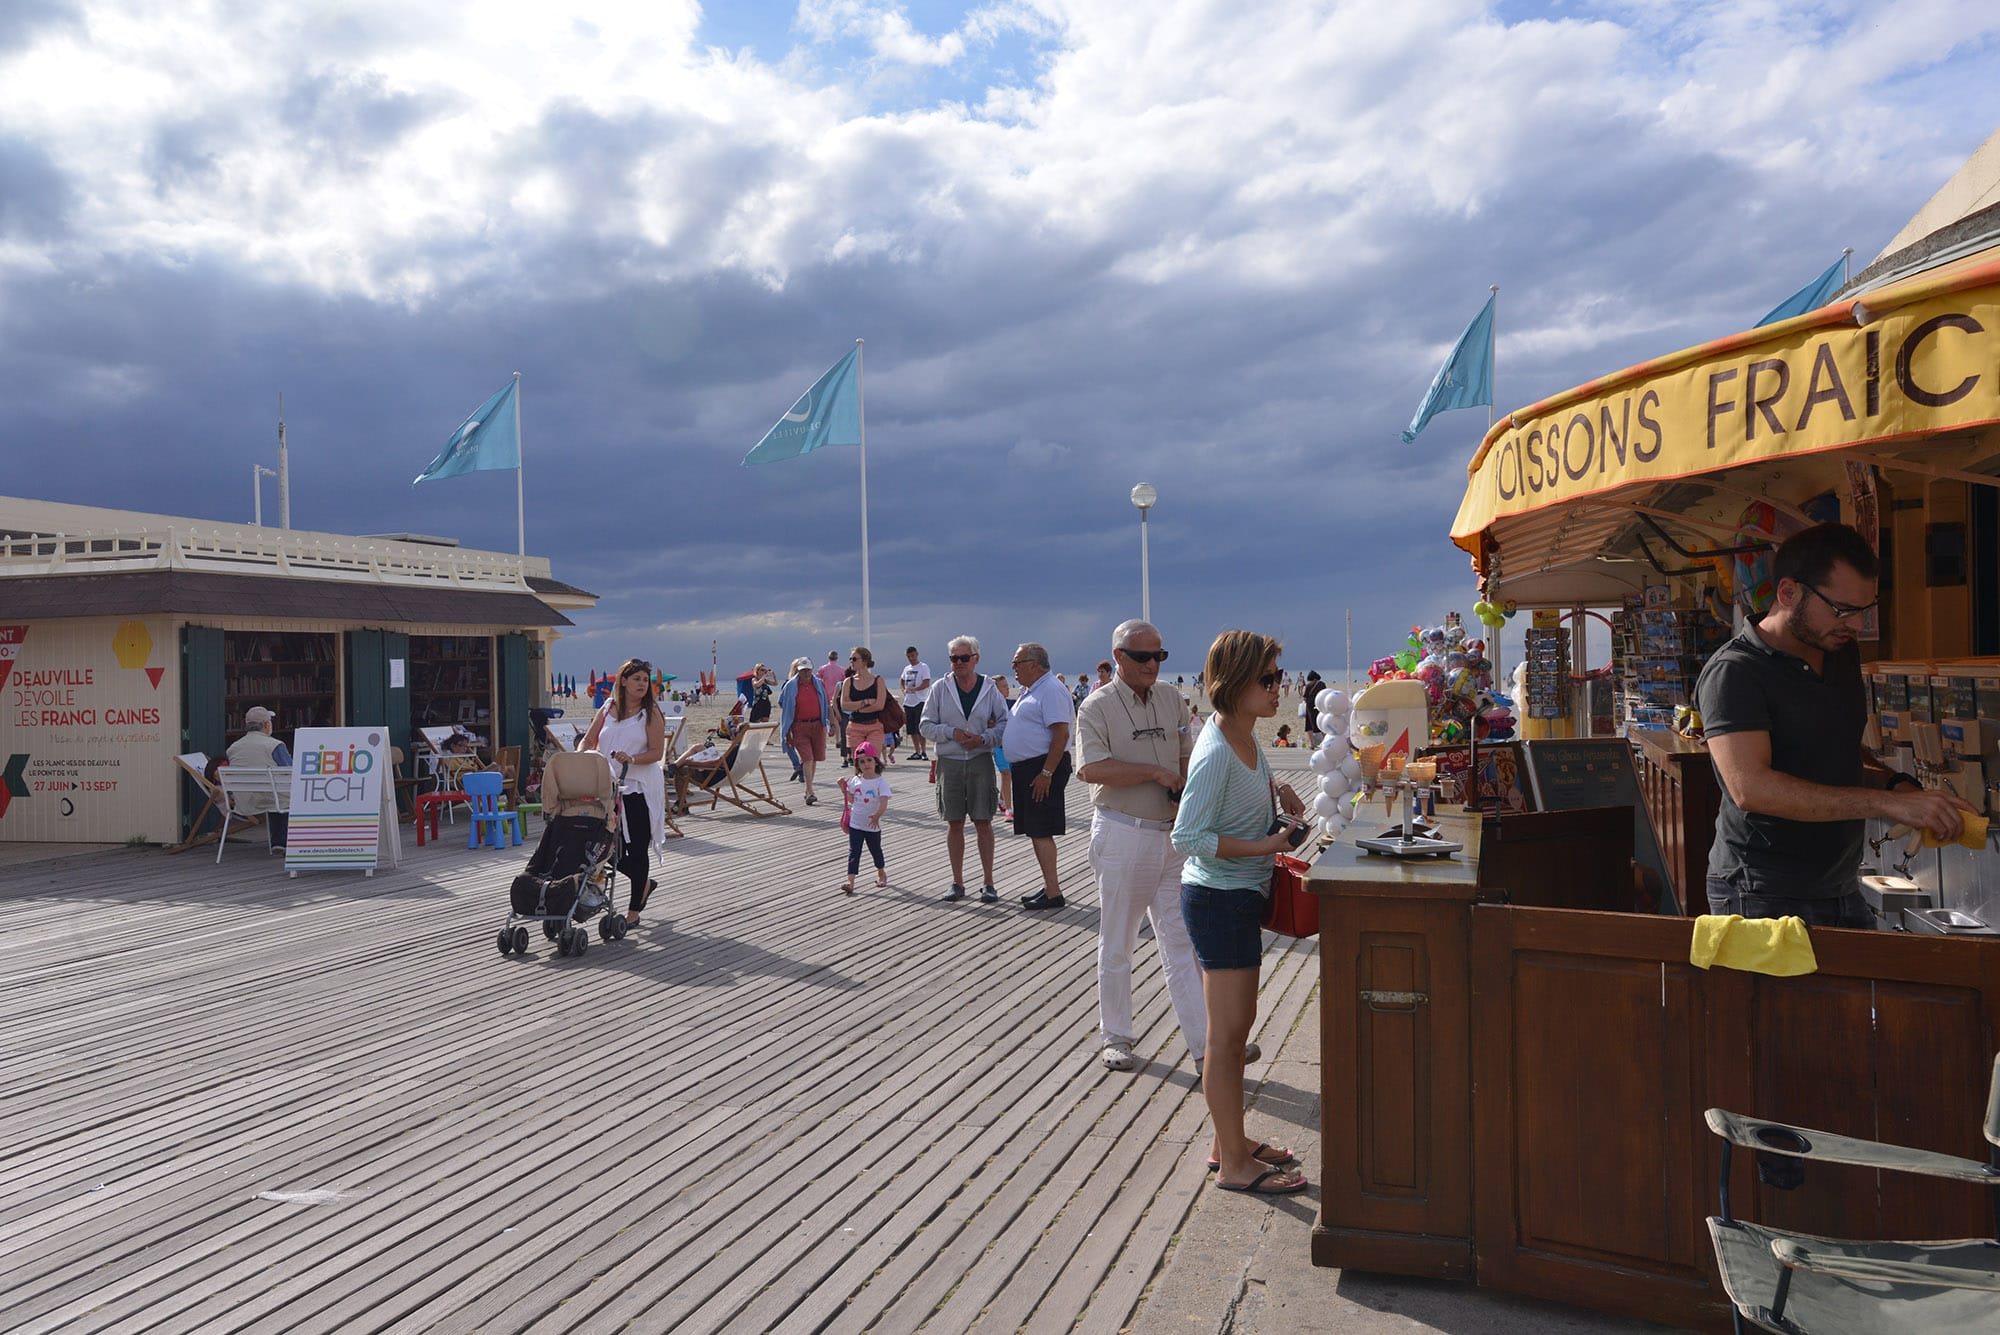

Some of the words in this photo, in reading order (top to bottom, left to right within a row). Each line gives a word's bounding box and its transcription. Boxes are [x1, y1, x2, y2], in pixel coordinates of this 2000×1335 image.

[13, 669, 93, 687] DEAUVILLE
[34, 781, 45, 791] 27
[47, 781, 70, 792] JUIN
[80, 781, 92, 791] 13
[94, 781, 118, 792] SEPT
[300, 776, 366, 802] TECH
